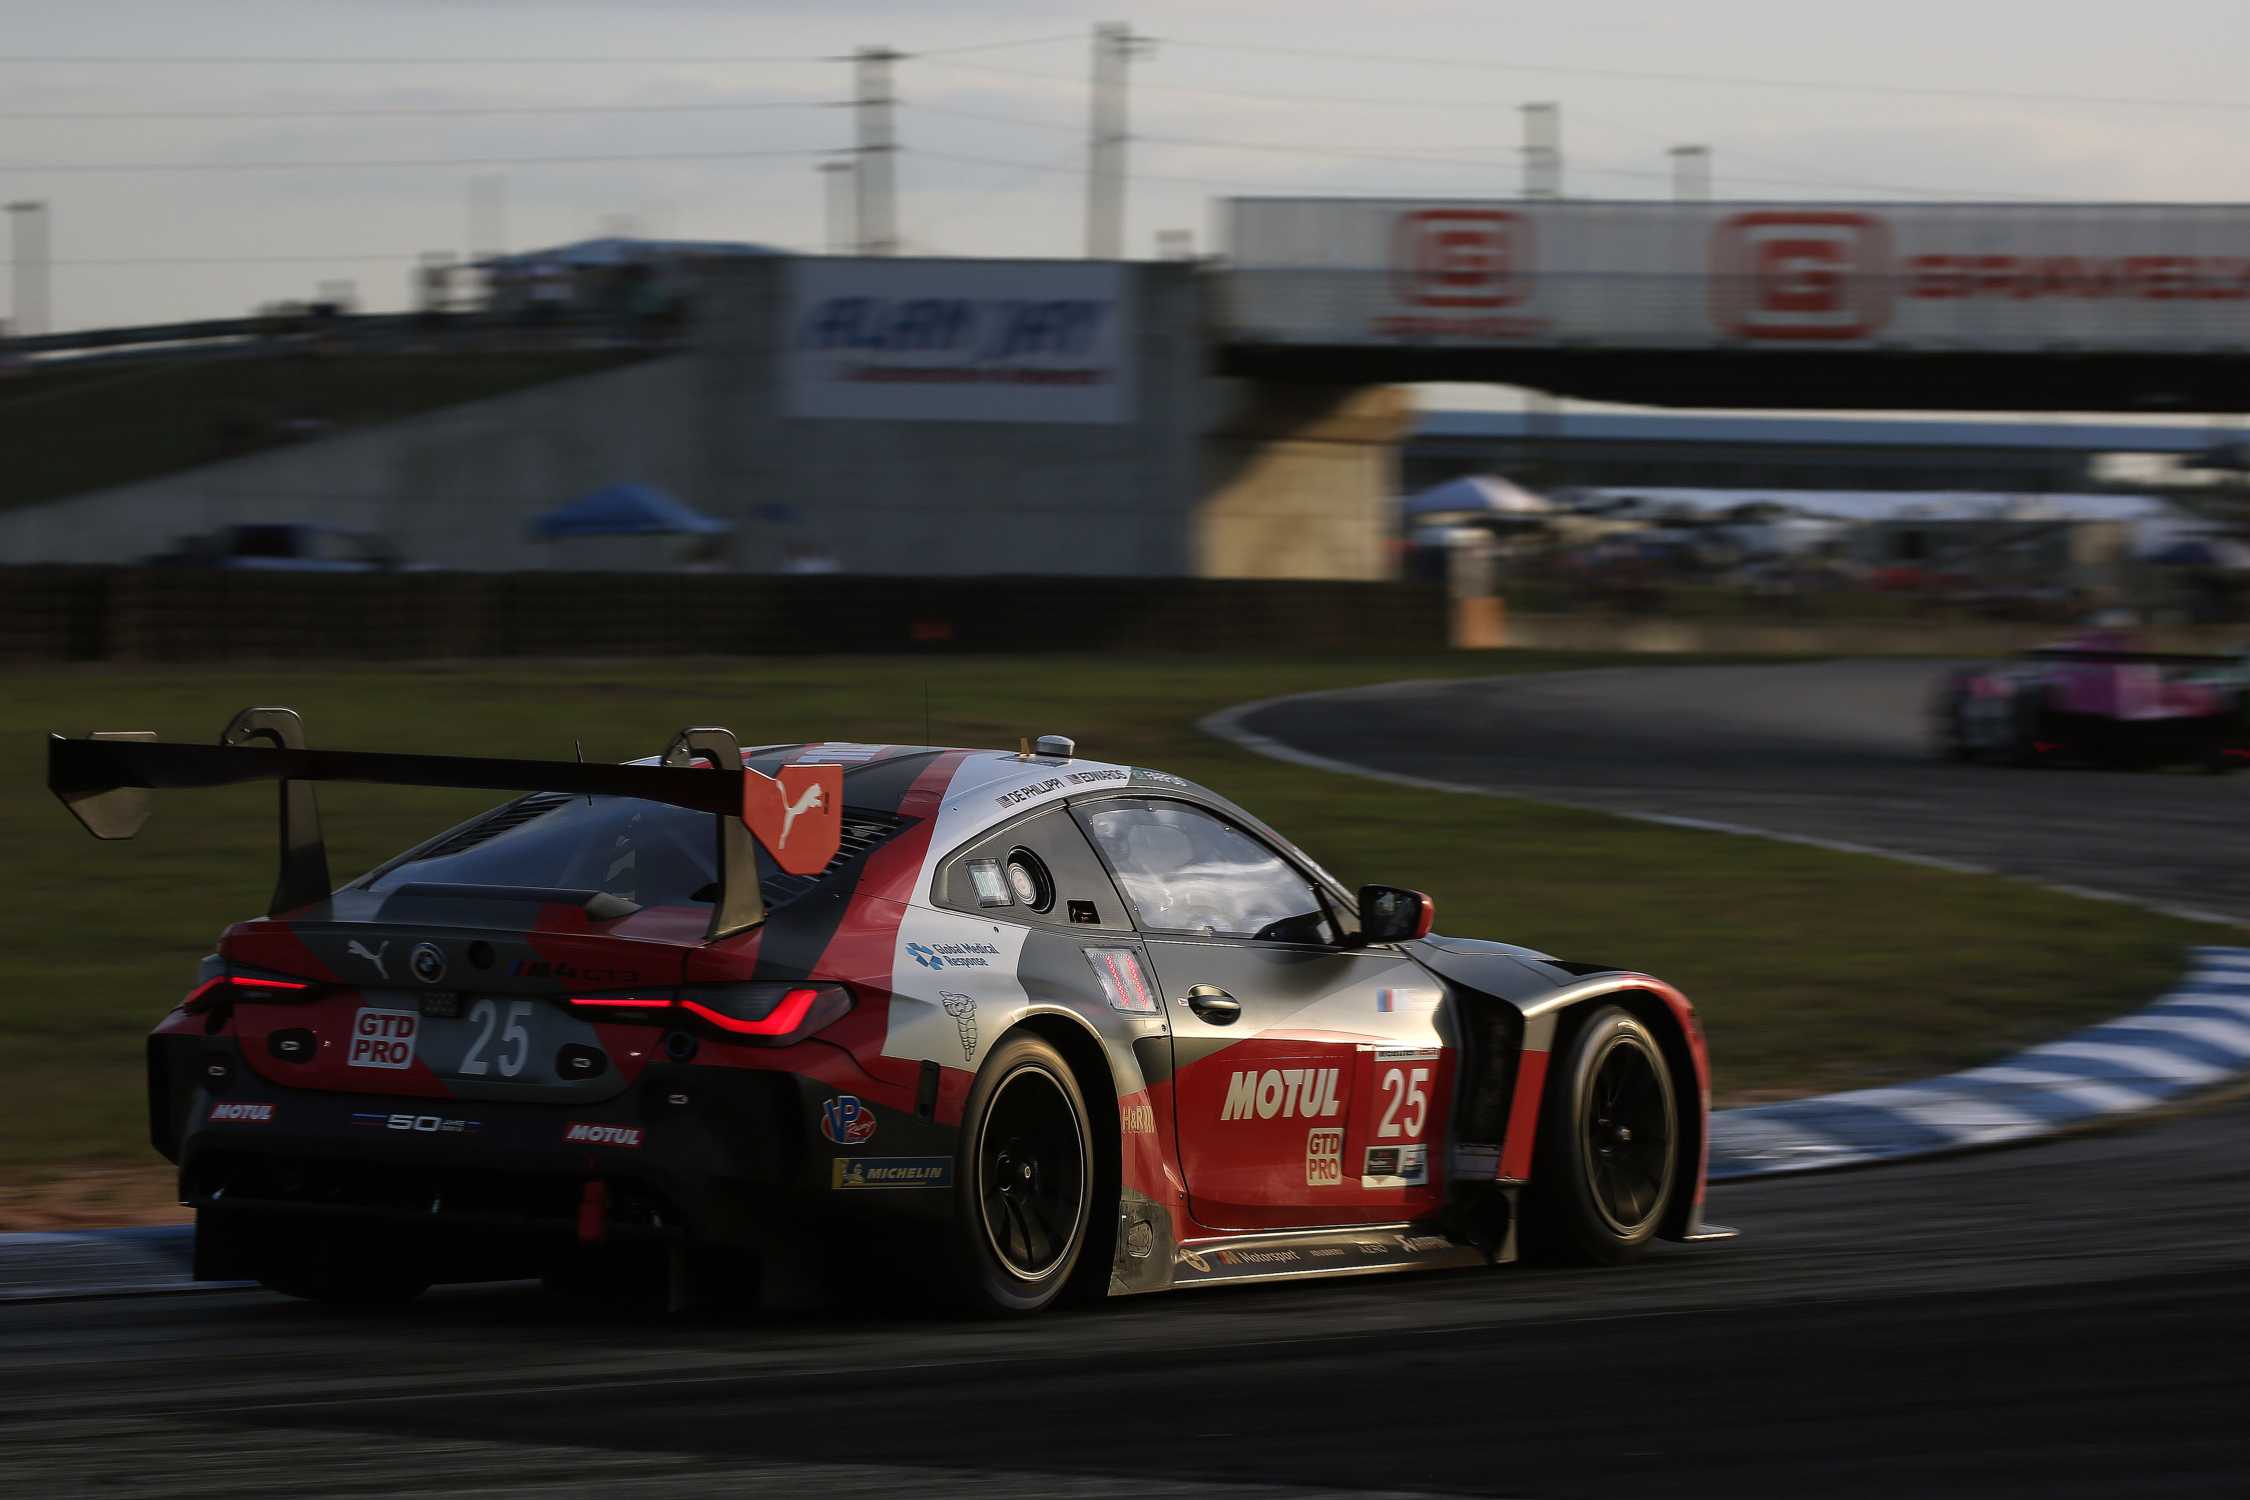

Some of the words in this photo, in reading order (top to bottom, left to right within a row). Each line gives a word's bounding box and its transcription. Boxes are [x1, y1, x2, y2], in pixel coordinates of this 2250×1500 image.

[1008, 790, 1027, 804] DE
[1079, 769, 1128, 784] EDWARDS
[932, 943, 967, 954] Global
[960, 942, 1000, 954] Medical
[943, 955, 990, 969] Response
[358, 1013, 414, 1039] GTD
[457, 998, 533, 1078] 25
[353, 1039, 409, 1063] PRO
[1220, 1068, 1341, 1121] MOTUL
[1377, 1068, 1430, 1137] 25
[210, 1104, 273, 1121] MOTUL
[386, 1113, 442, 1132] 50
[566, 1125, 641, 1145] MOTUL
[1309, 1133, 1340, 1155] GTD
[866, 1167, 944, 1180] MICHELIN
[1308, 1158, 1338, 1180] PRO
[1238, 1248, 1301, 1264] Motorsport
